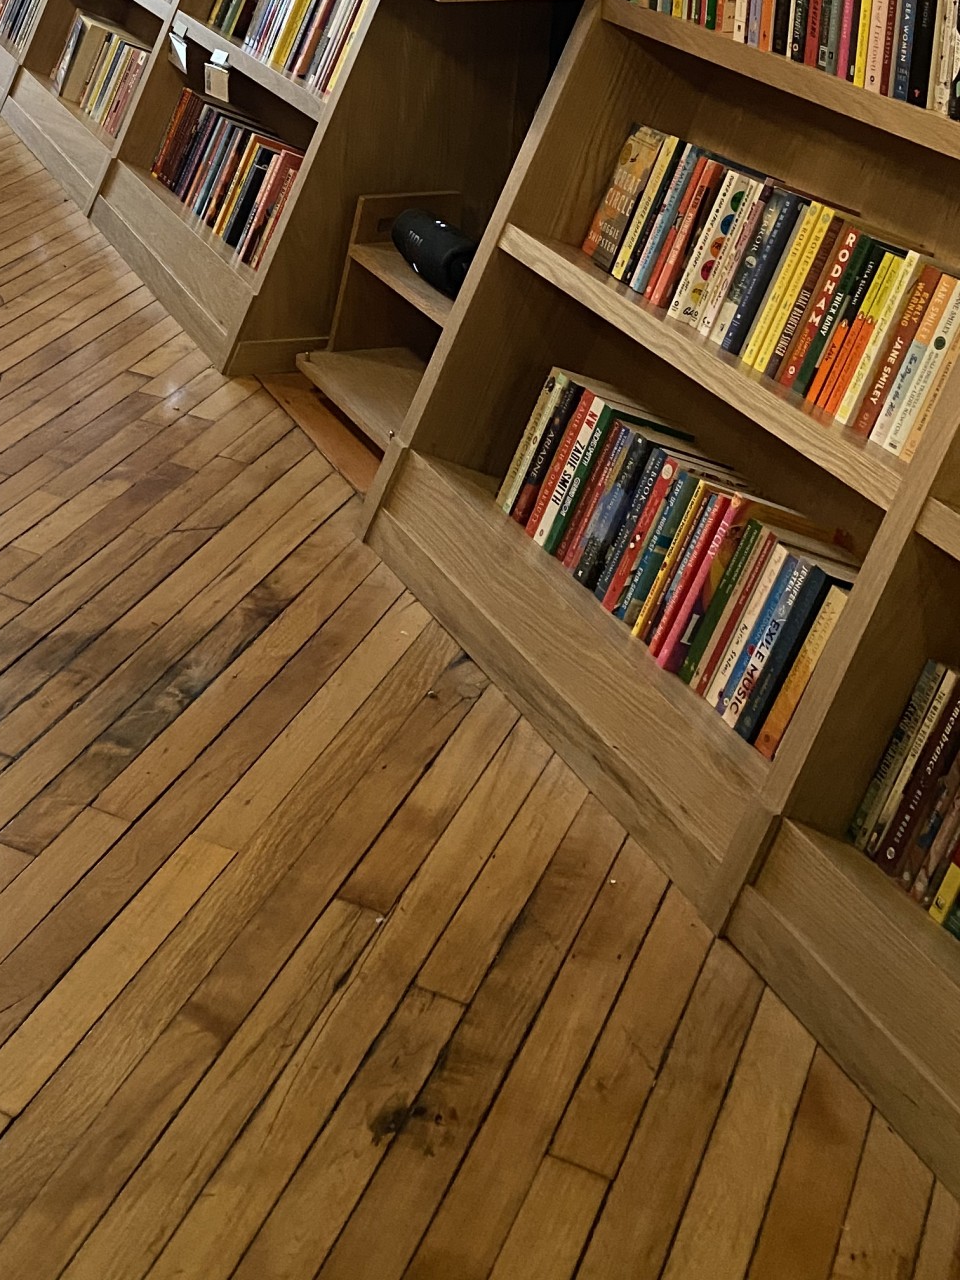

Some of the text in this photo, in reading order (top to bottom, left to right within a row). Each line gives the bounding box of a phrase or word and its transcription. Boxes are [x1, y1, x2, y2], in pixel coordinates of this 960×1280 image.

[900, 24, 908, 61] WOMEN
[751, 208, 774, 253] TERROR
[792, 226, 807, 255] ROSIE
[804, 235, 819, 266] ROSIE
[809, 233, 855, 325] RODHAM
[863, 261, 874, 278] LEILA
[818, 291, 843, 336] TRICK BABY
[901, 281, 925, 326] WARNING
[911, 291, 928, 322] EARLY
[920, 281, 950, 338] JANE SMILEY
[869, 336, 903, 403] JANE SMILEY
[573, 401, 586, 428] ZADIE
[583, 410, 598, 429] NW
[531, 431, 554, 476] ARIADNE
[558, 432, 575, 460] SMITH
[566, 440, 585, 470] ZADIE
[546, 473, 556, 487] ON
[550, 470, 572, 505] SMITH
[640, 471, 656, 501] BOOK
[671, 478, 683, 496] STAY
[531, 489, 548, 522] BEAUTY
[667, 496, 675, 506] UP
[707, 520, 728, 559] LUCKY
[785, 570, 799, 592] STEIL
[787, 566, 809, 605] JENNIFER
[729, 620, 779, 713] EXILE MUSIC
